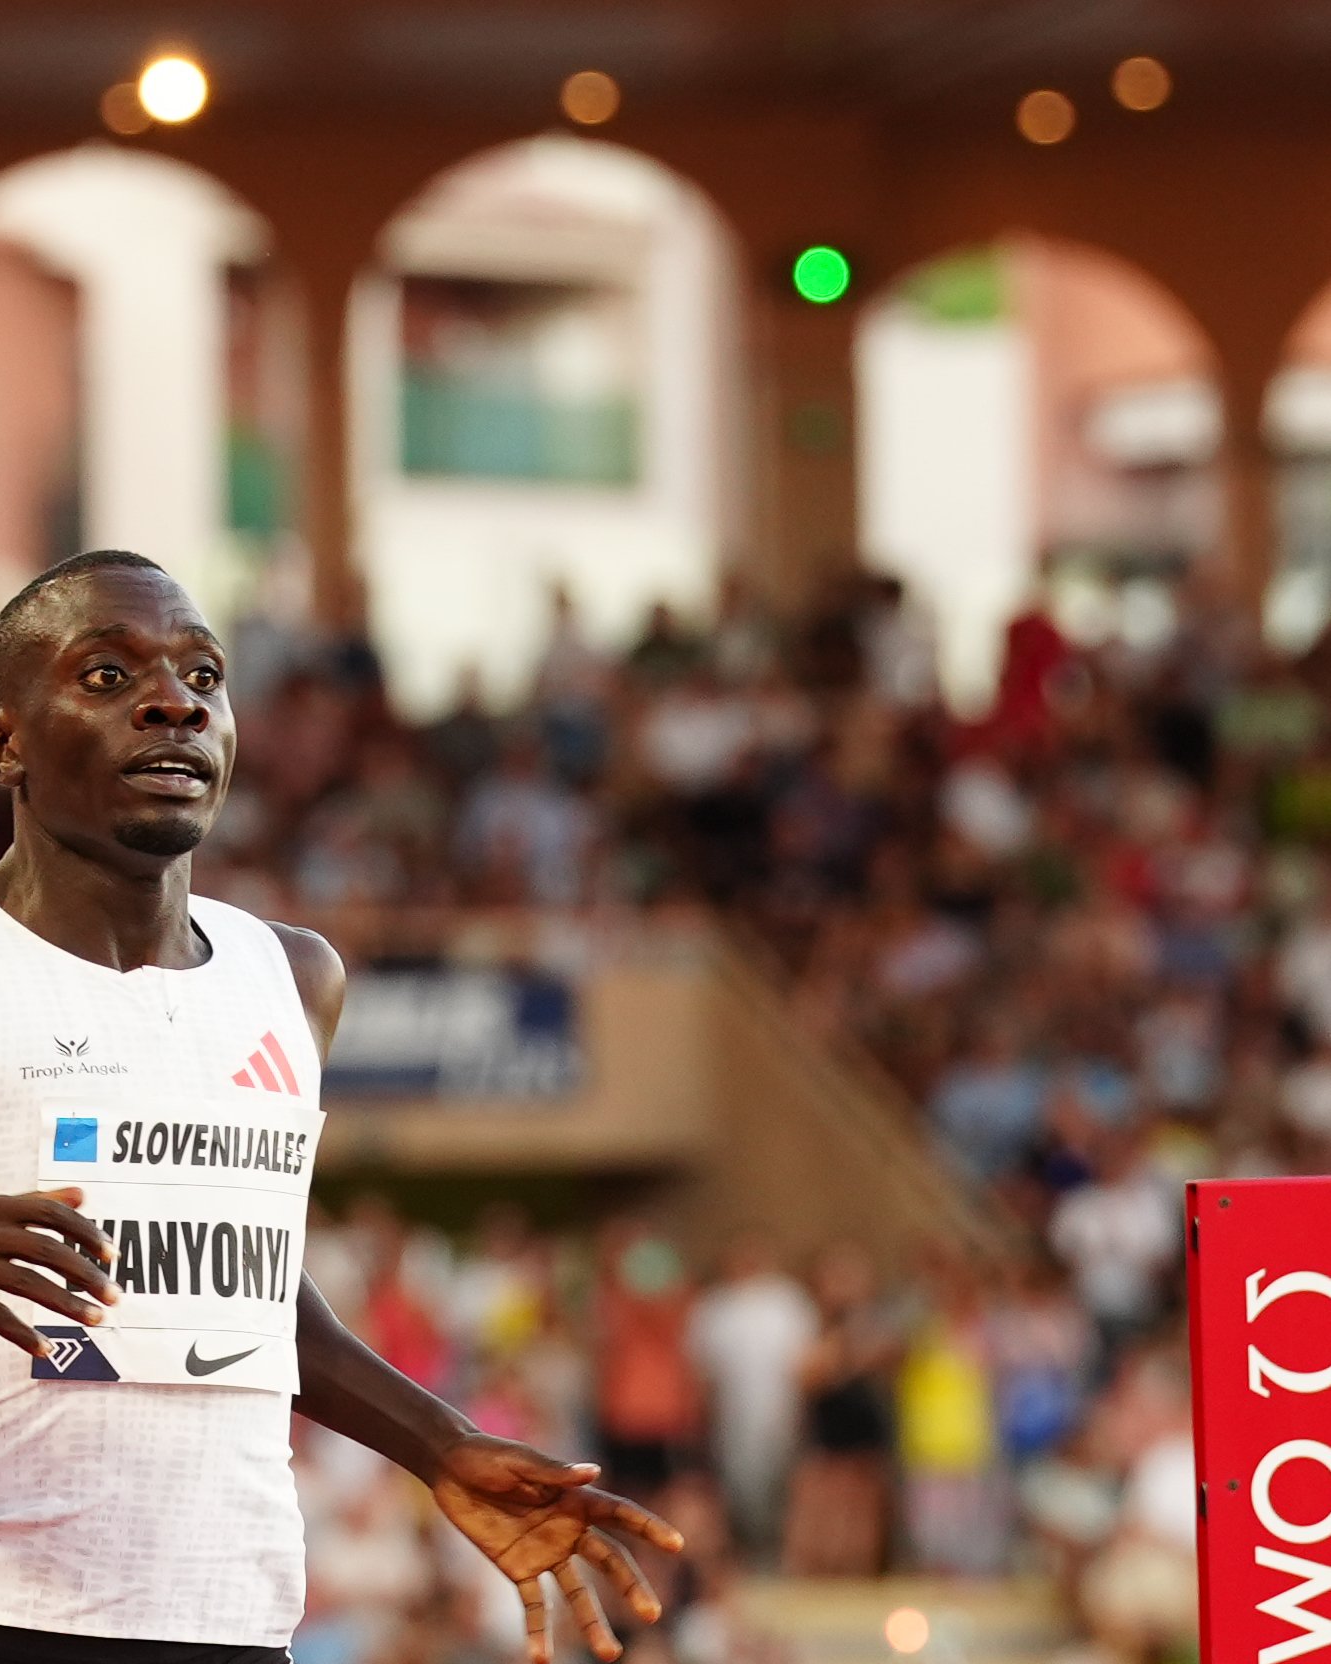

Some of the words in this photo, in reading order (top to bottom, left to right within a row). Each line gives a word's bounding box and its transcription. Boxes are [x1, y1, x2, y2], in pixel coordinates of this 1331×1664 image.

[19, 1062, 74, 1080] Tirop's
[78, 1061, 129, 1076] Angels
[112, 1120, 307, 1176] SLOVENIJALES
